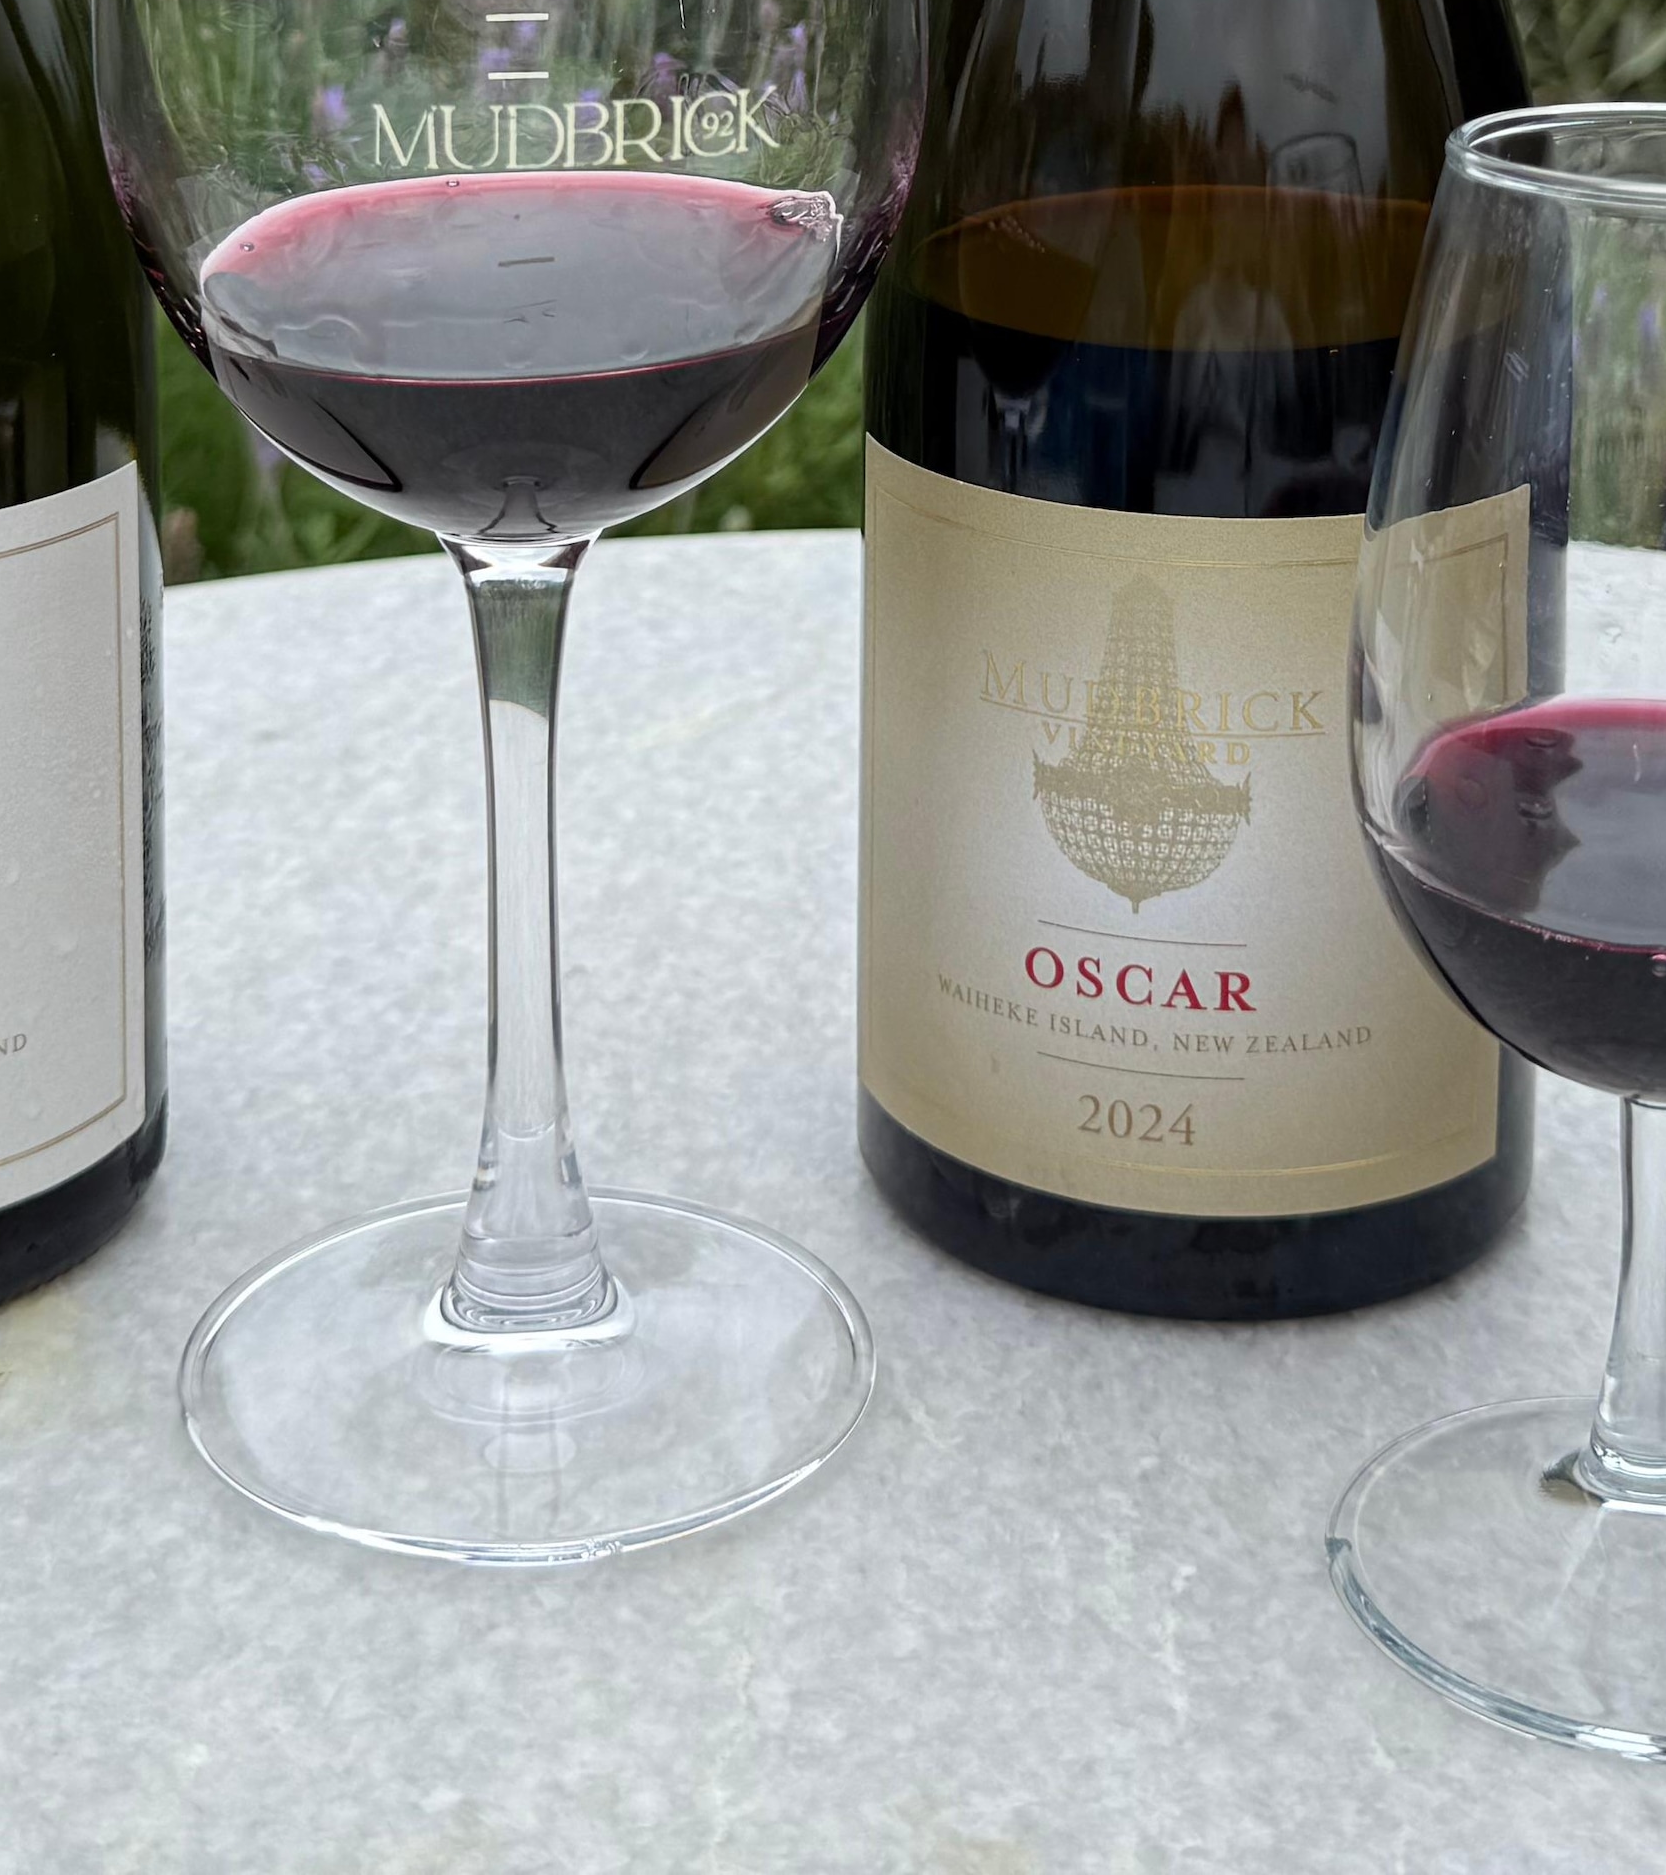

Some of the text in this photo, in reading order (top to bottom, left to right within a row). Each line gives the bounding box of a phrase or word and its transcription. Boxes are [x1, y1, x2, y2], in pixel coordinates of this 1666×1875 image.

[372, 85, 780, 170] MUDBRICK
[937, 974, 1373, 1055] WAIHEKE ISLAND, NEW ZEALAND
[1024, 946, 1258, 1013] OSCAR
[1077, 1094, 1197, 1146] 2024
